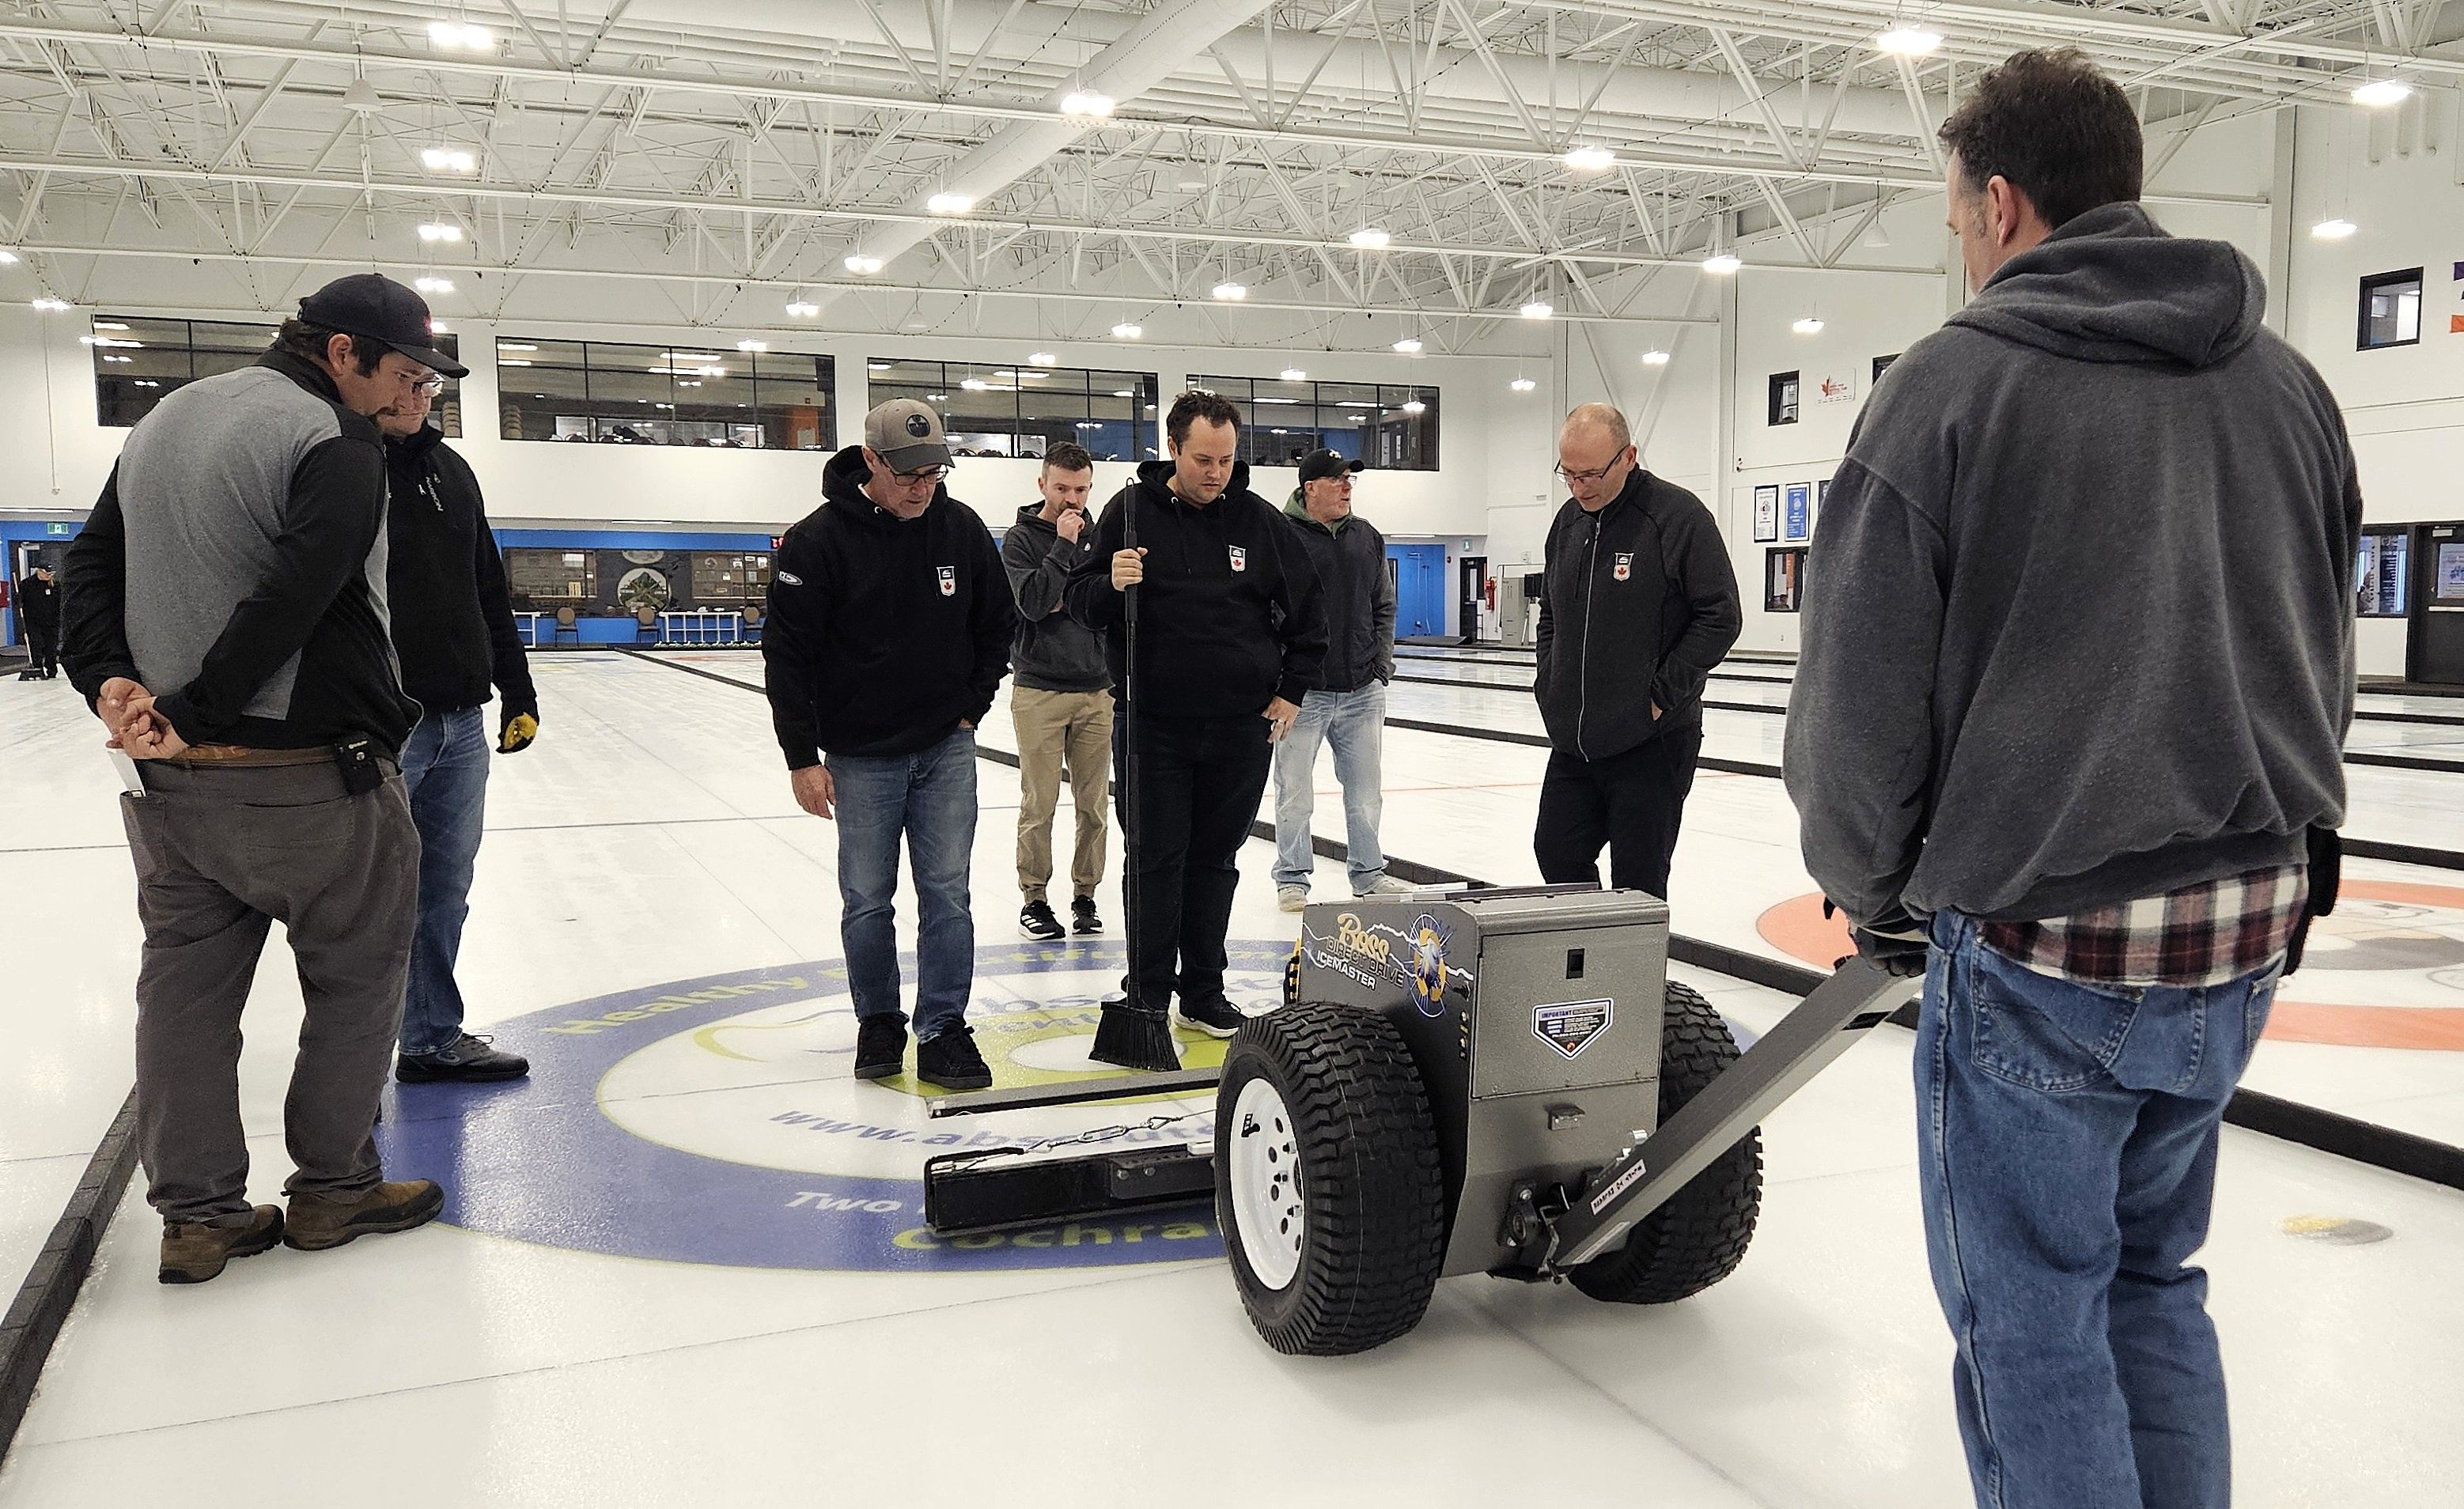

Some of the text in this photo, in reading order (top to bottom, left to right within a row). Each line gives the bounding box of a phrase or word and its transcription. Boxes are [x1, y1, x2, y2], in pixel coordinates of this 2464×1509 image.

[1337, 912, 1390, 965] Boss
[1317, 950, 1376, 990] ICEMASTER
[1327, 936, 1405, 988] DIRECT DRIVE
[539, 976, 808, 1034] Healthy
[1541, 1010, 1573, 1019] IMPORTANT
[785, 1191, 903, 1213] Two
[891, 1223, 1210, 1250] Cochra
